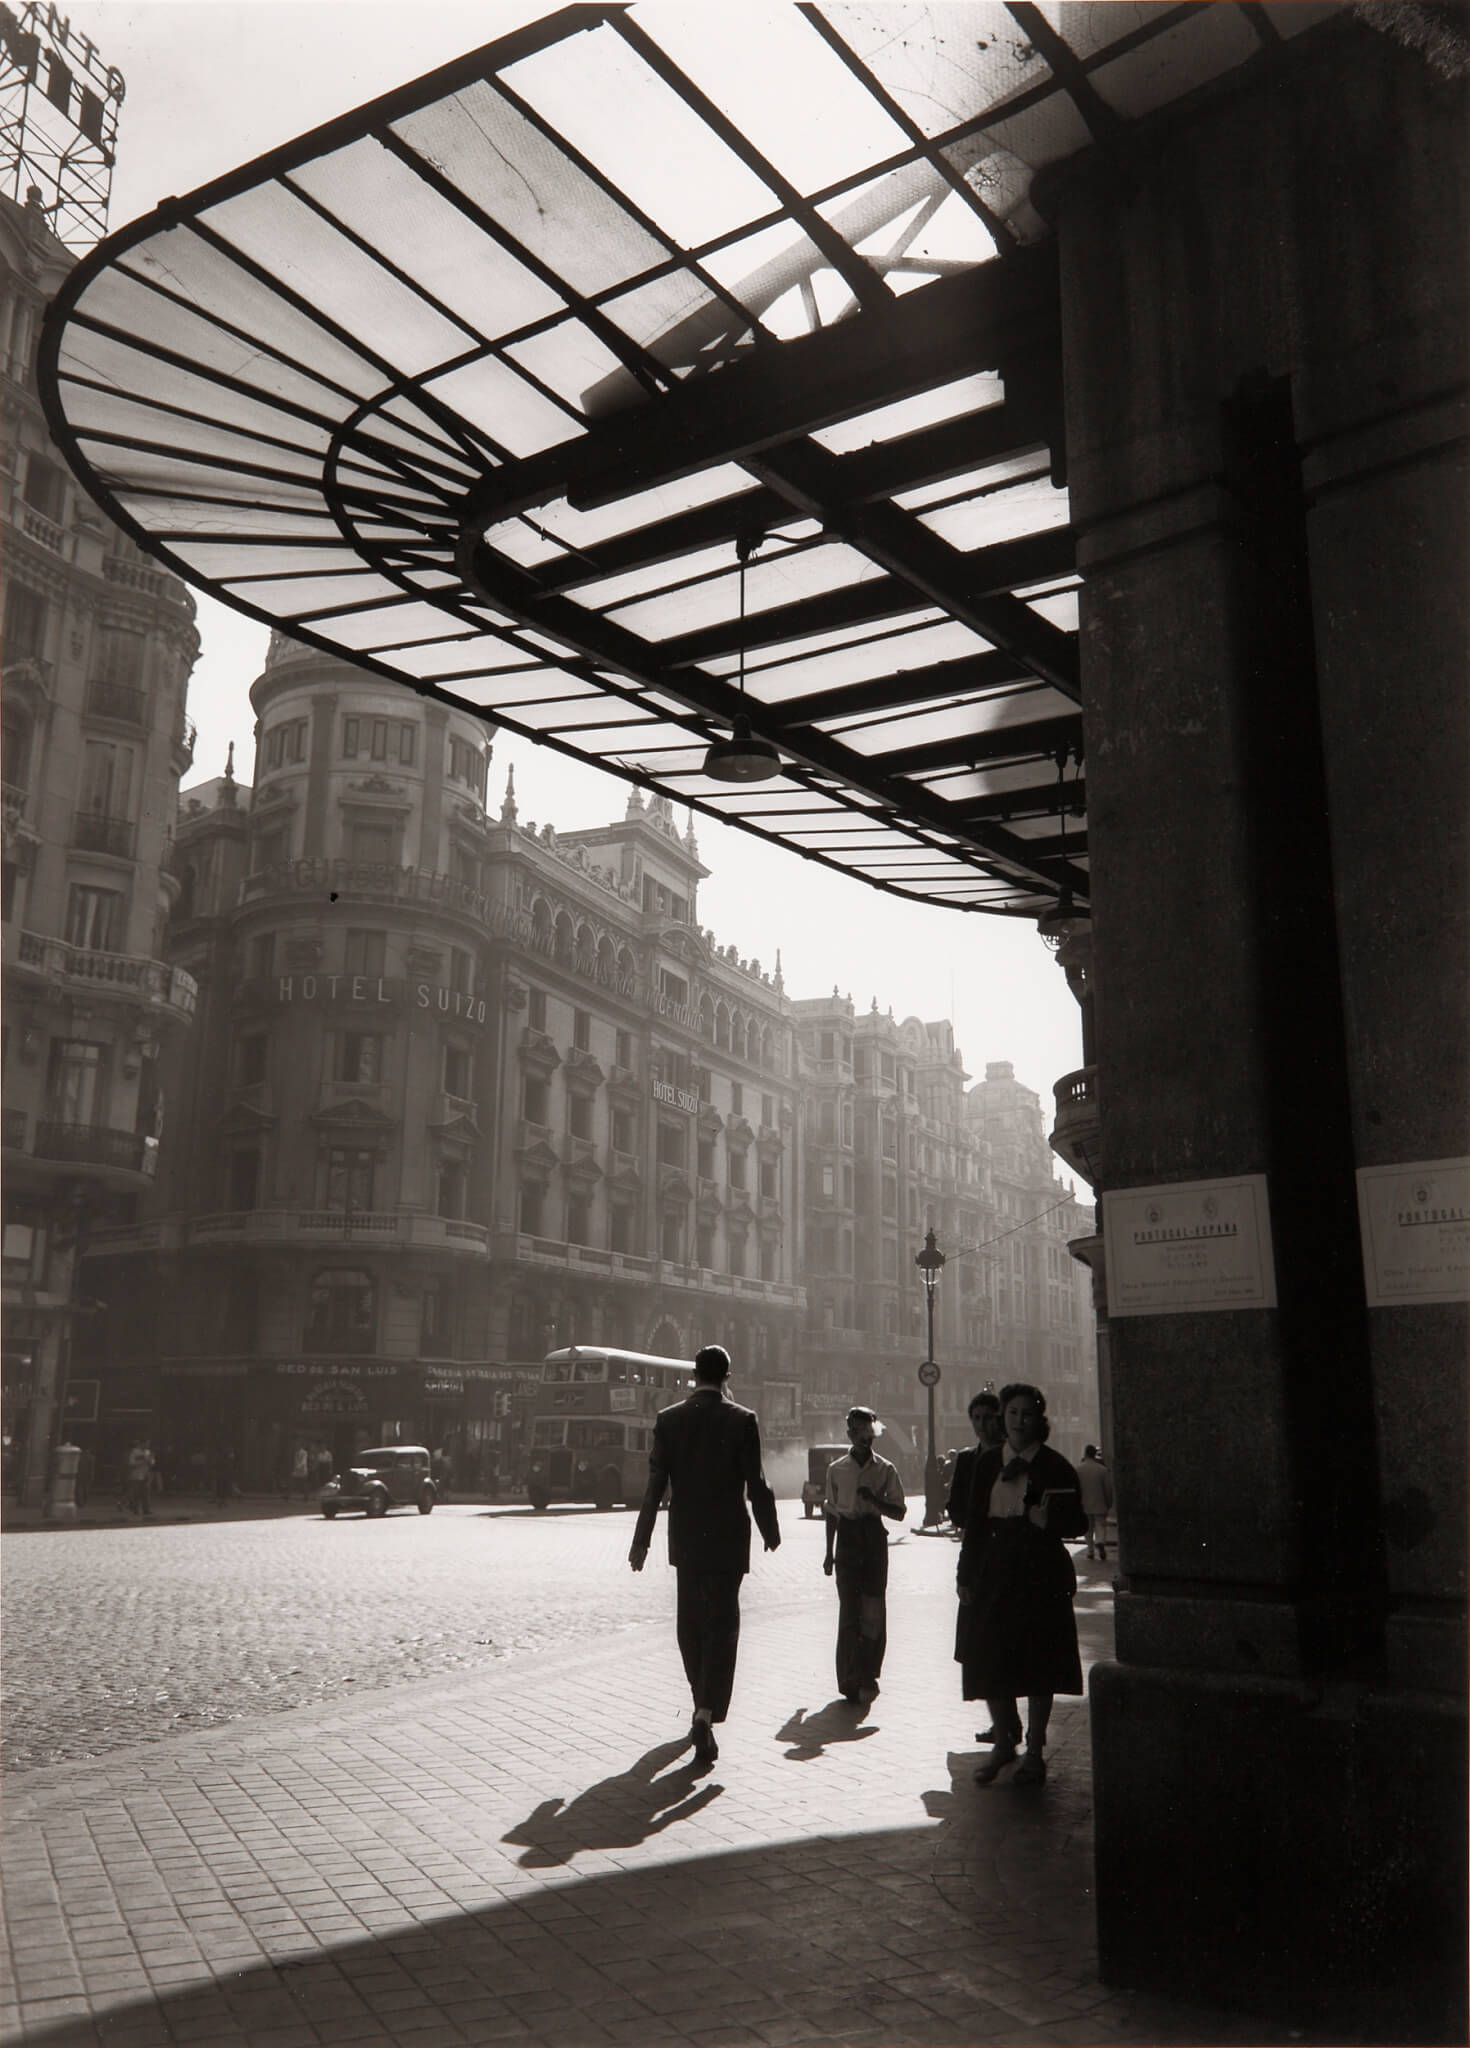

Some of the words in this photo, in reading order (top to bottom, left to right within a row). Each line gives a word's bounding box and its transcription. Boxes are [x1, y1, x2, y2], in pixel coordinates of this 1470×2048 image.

[279, 975, 393, 1003] HOTEL
[417, 984, 487, 1024] SUIZO
[653, 1079, 677, 1105] HOTEL
[677, 1090, 699, 1114] SUIZO
[276, 1363, 306, 1375] RED
[328, 1364, 361, 1376] SAN
[366, 1365, 400, 1376] LUIS
